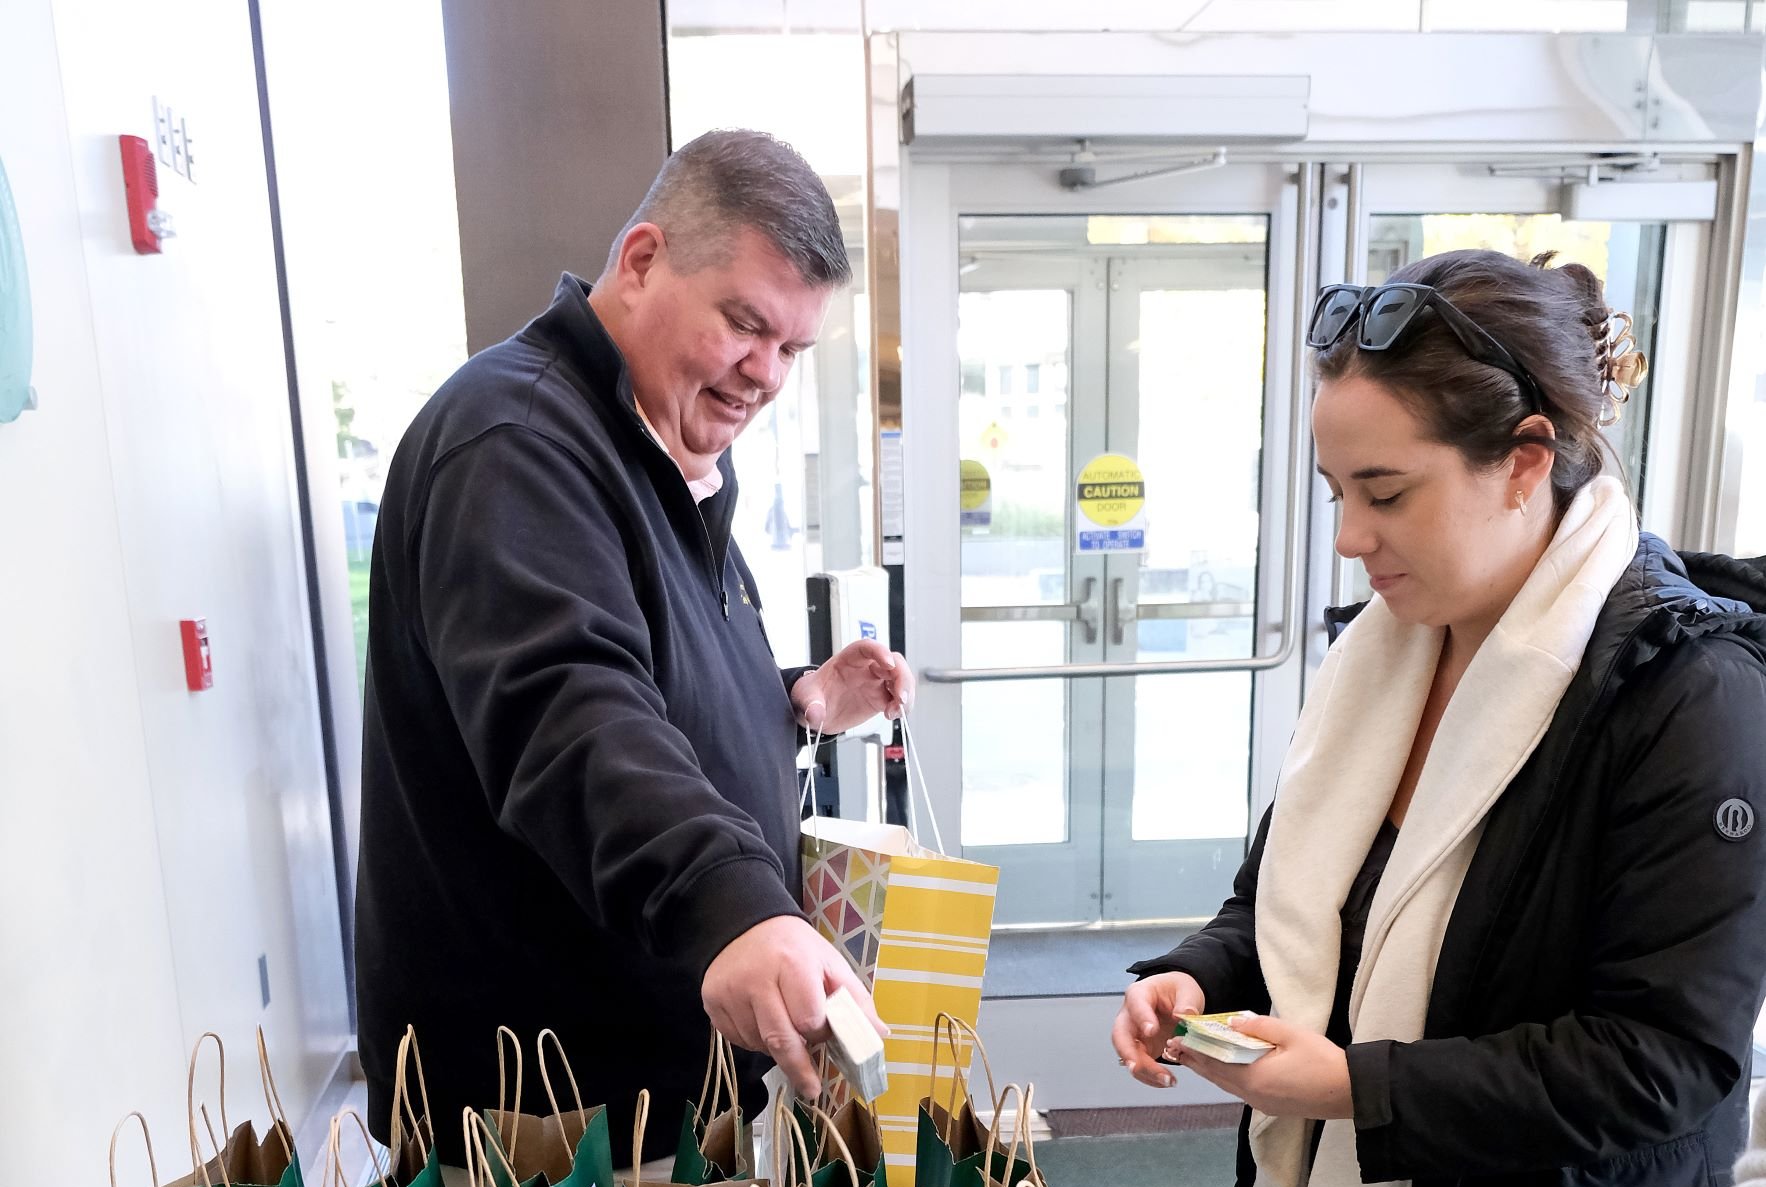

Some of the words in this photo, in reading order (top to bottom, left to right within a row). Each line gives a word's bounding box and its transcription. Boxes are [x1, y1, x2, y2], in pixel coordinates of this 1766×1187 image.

[1083, 470, 1140, 481] AUTOMATIC
[1083, 484, 1139, 498] CAUTION
[1097, 502, 1127, 513] DOOR
